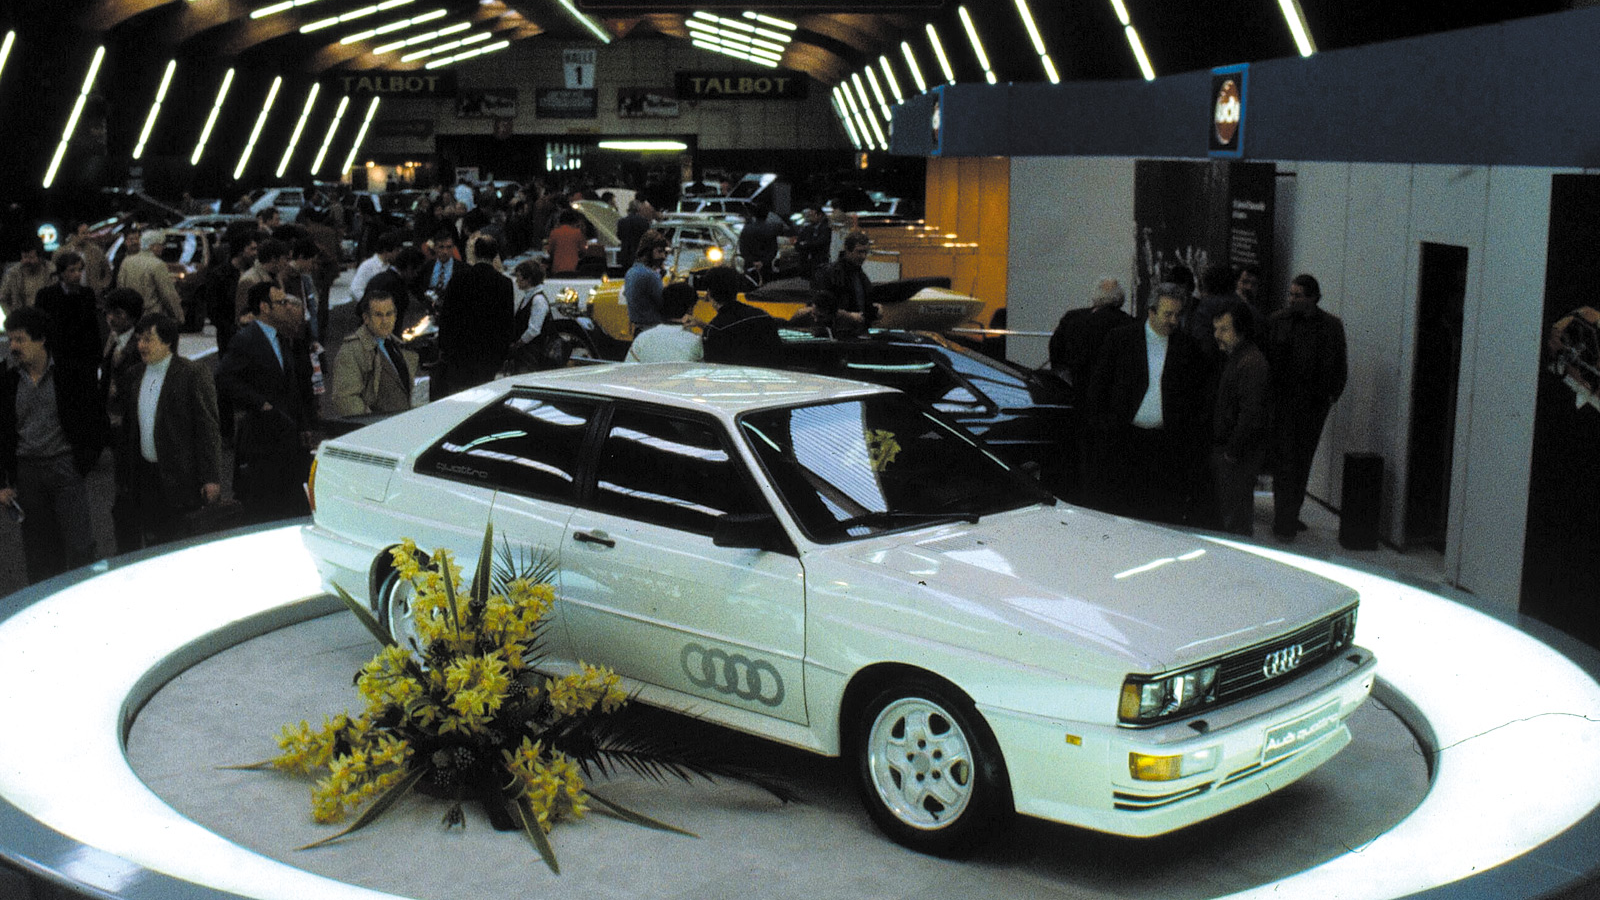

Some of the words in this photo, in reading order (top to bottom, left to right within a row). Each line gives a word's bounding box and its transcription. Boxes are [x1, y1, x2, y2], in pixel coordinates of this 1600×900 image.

[340, 76, 440, 92] TALBOT
[576, 67, 583, 85] 1
[689, 77, 790, 94] TALBOT
[436, 462, 488, 478] quattro
[1266, 732, 1296, 752] Audi
